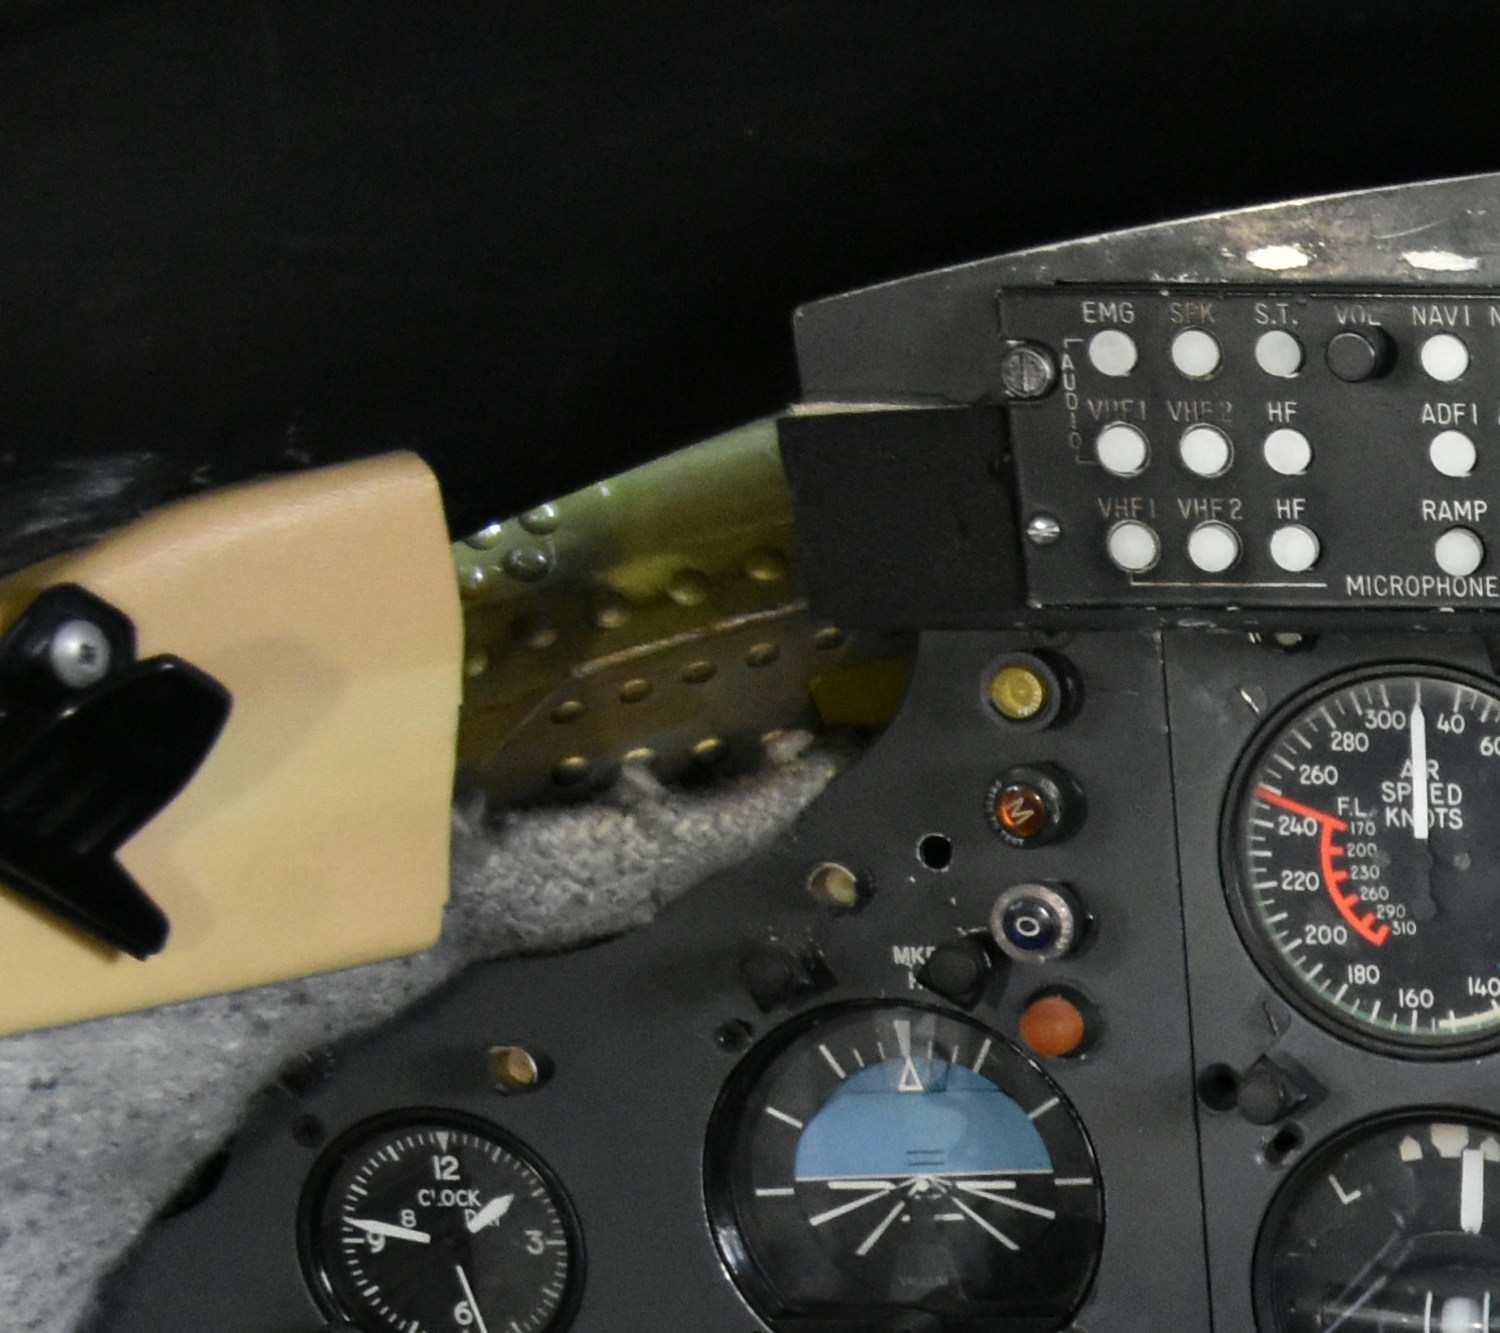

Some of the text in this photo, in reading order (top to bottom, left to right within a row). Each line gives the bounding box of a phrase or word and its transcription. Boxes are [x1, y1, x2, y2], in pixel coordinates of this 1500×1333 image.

[1081, 300, 1135, 324] EMG
[1421, 499, 1488, 522] RAMP
[1345, 574, 1499, 598] MICROPHONE
[1330, 729, 1370, 753] 280
[1398, 988, 1435, 1009] 160
